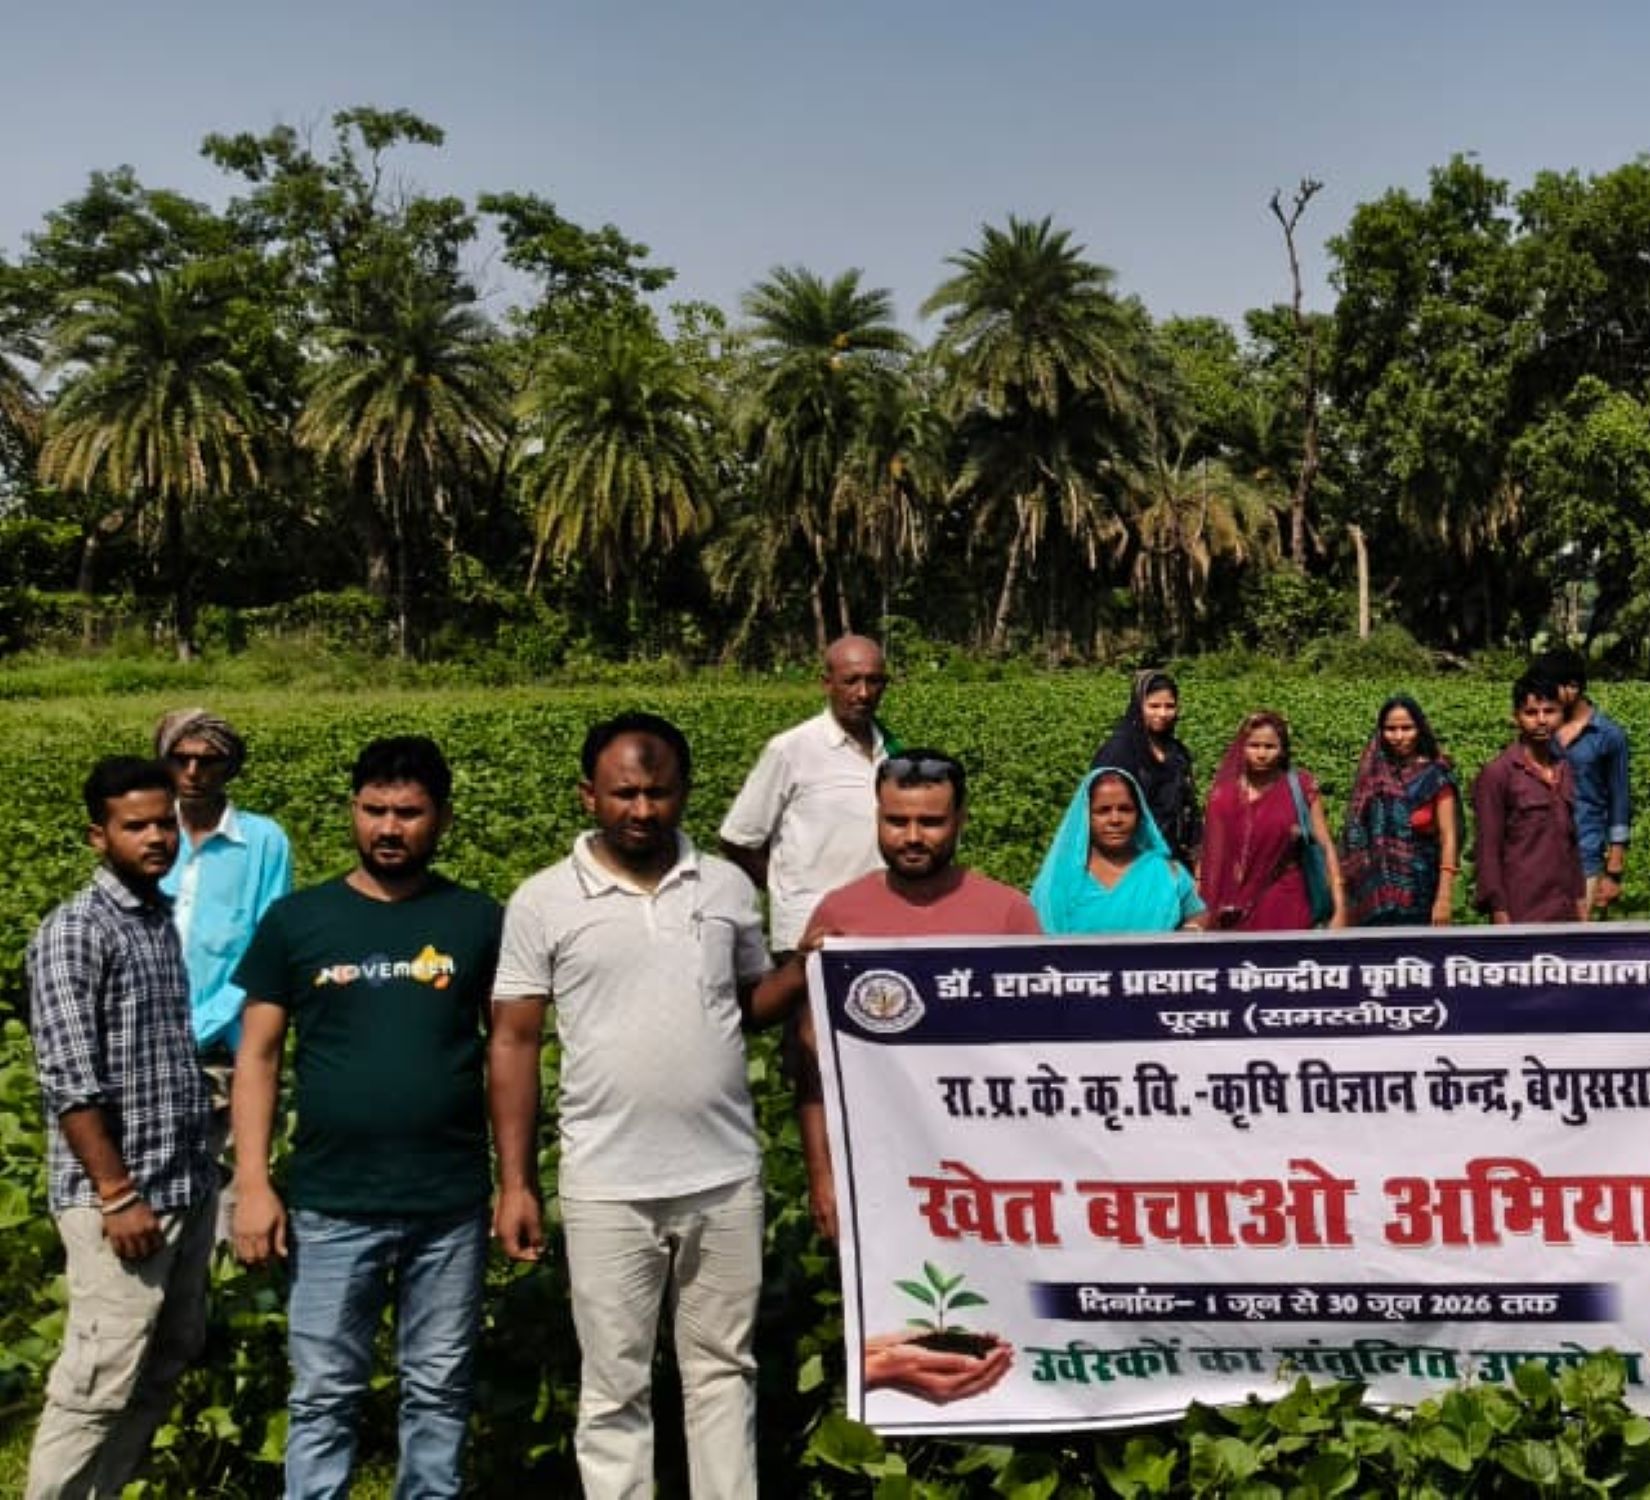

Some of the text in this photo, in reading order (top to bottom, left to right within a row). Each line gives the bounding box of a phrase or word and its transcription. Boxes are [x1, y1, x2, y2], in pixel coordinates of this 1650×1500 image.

[935, 968, 982, 998] डॉ.
[993, 965, 1112, 997] राजेन्द्र
[1121, 968, 1219, 995] प्रसाद
[1228, 959, 1351, 992] केन्द्रीय
[1359, 956, 1434, 997] कृषि
[1158, 999, 1449, 1034] पूसा (समस्तीपुर)
[1297, 1059, 1418, 1114] विज्ञान
[909, 1160, 1062, 1245] खेत
[1076, 1159, 1355, 1246] बचाओ
[1206, 1295, 1217, 1313] 1
[1228, 1294, 1282, 1320] जून
[1290, 1289, 1320, 1313] से
[1329, 1294, 1359, 1313] 30
[1367, 1294, 1423, 1320] जून
[1431, 1295, 1493, 1314] 2026
[1499, 1294, 1559, 1314] तक
[1023, 1336, 1183, 1385] उर्वरकों
[1189, 1345, 1264, 1376] का
[1272, 1339, 1461, 1383] संतुलित
